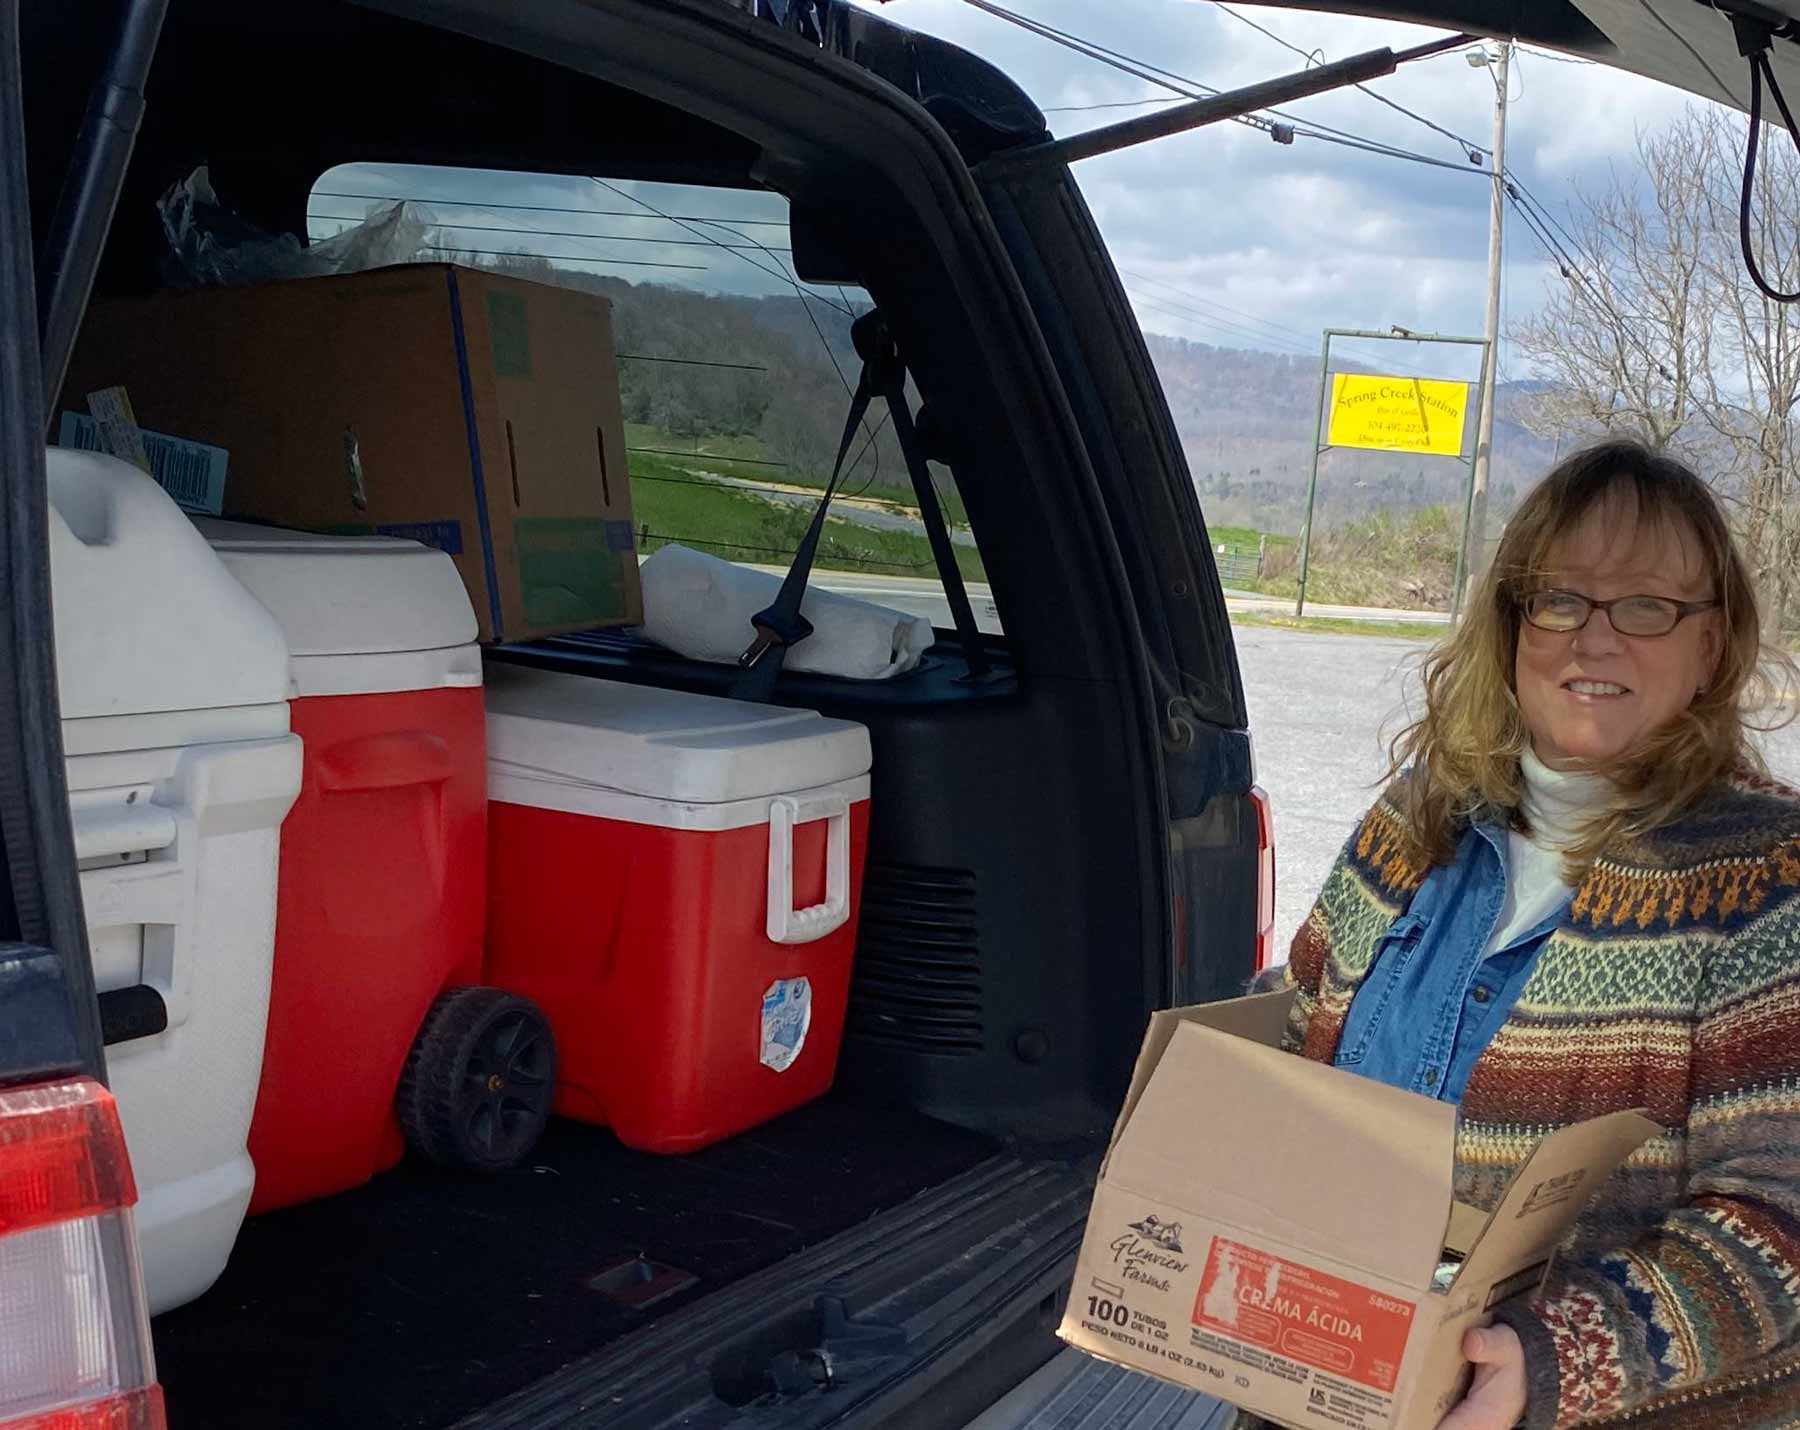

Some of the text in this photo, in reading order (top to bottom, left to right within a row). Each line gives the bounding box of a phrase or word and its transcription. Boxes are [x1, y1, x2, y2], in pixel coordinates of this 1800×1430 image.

[1338, 386, 1458, 418] Spring Creek Station
[1110, 1234, 1190, 1272] Glenview
[1122, 1258, 1169, 1290] Farms
[1088, 1296, 1129, 1327] 100
[1133, 1310, 1167, 1330] TUBOS
[1239, 1286, 1301, 1320] CREMA
[1306, 1305, 1363, 1343] ÁCIDA
[1131, 1321, 1144, 1334] DE
[1154, 1329, 1169, 1341] OZ
[1081, 1320, 1108, 1336] PESO
[1110, 1329, 1136, 1346] NETO
[1146, 1342, 1158, 1354] LB
[1160, 1347, 1167, 1358] 4
[1168, 1350, 1183, 1363] OZ
[1209, 1363, 1225, 1379] kg)
